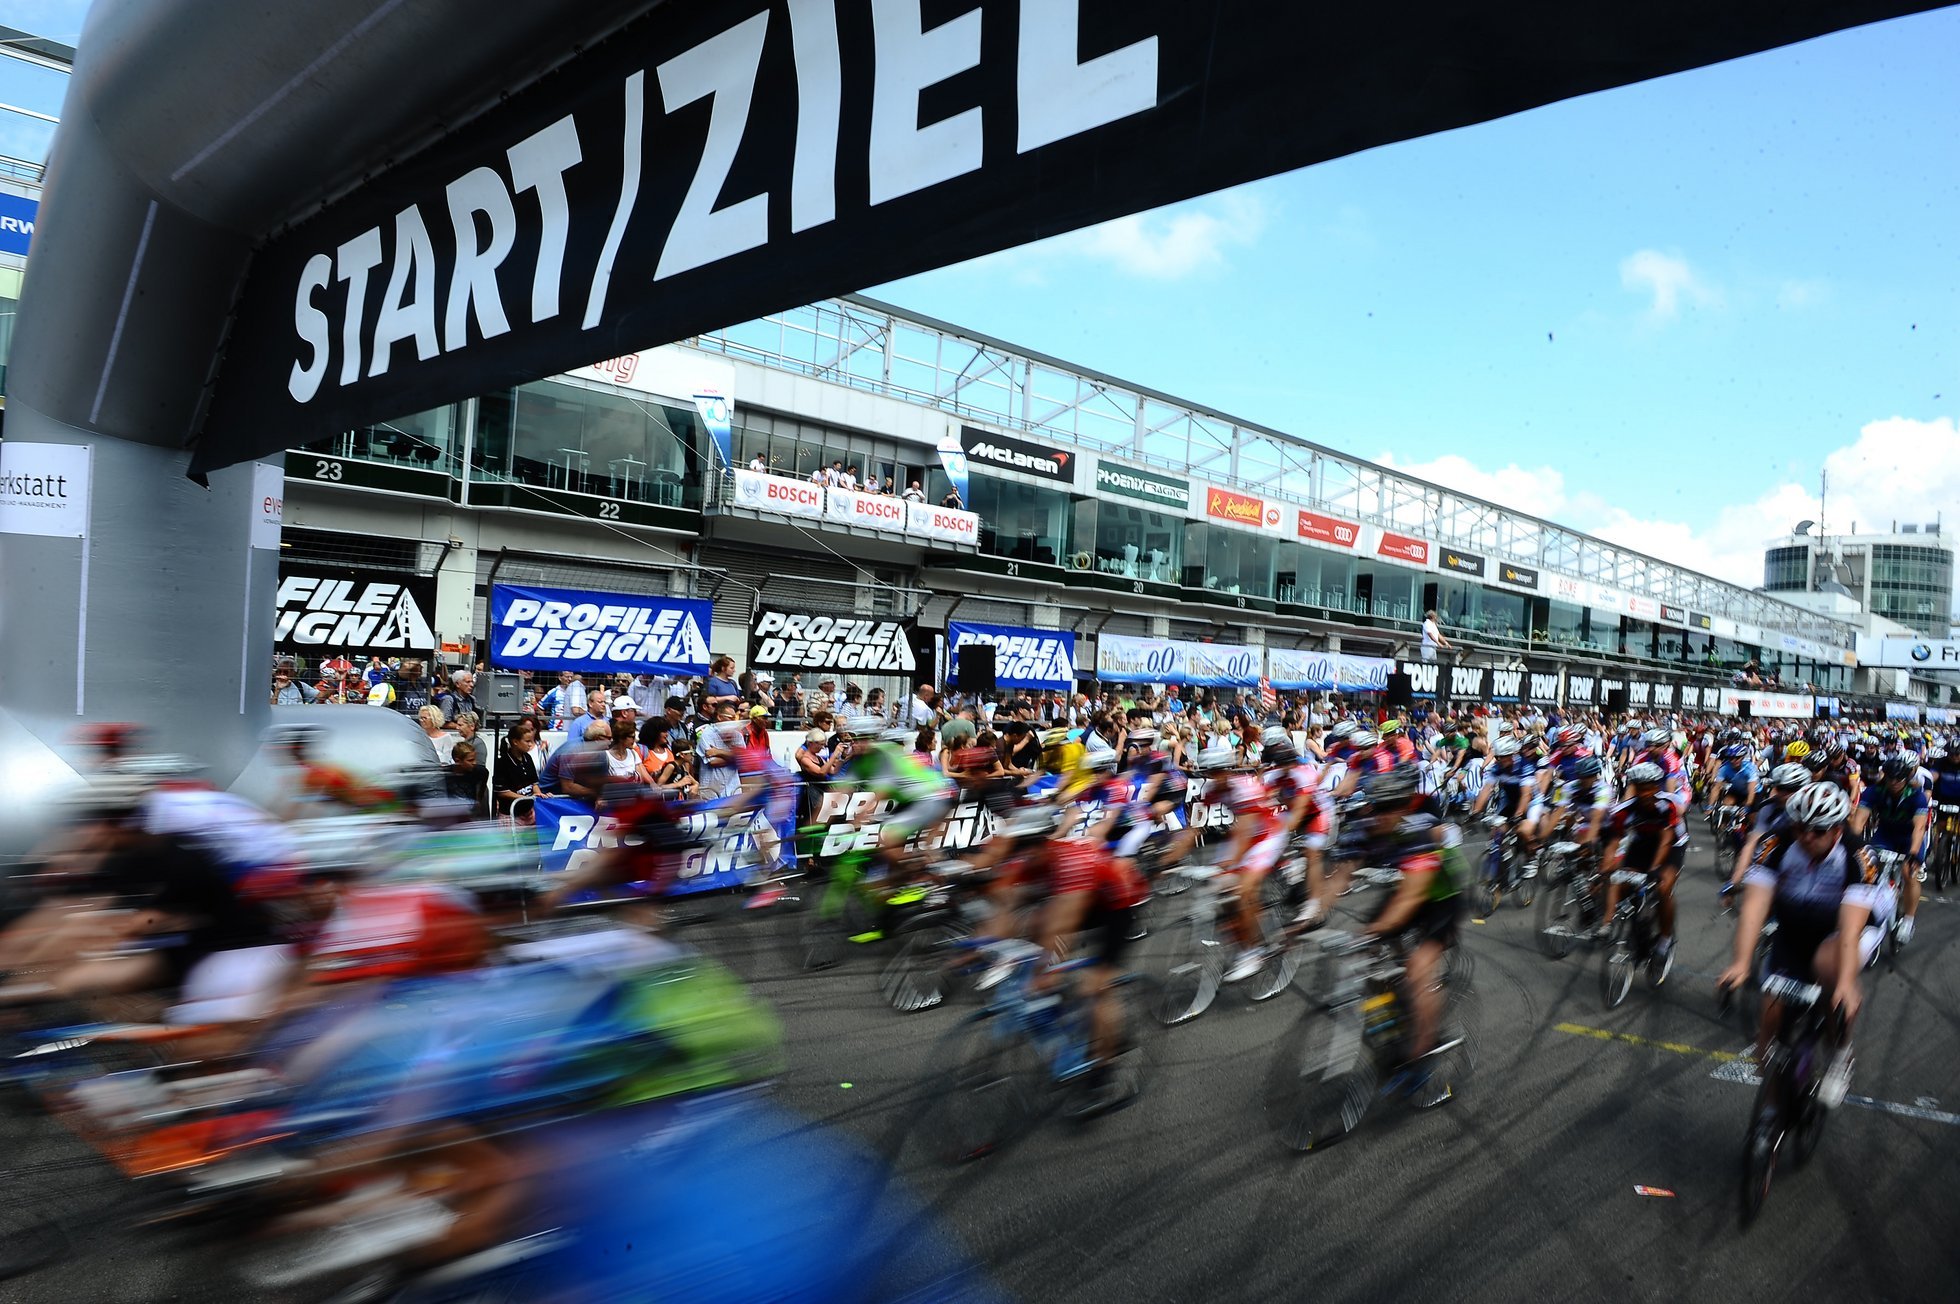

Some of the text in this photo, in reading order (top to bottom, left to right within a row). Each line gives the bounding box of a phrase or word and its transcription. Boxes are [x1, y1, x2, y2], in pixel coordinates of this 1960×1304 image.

[315, 460, 343, 481] 23
[968, 442, 1059, 475] McLaren
[767, 483, 818, 506] BOSCH
[599, 502, 620, 520] 22
[855, 499, 901, 521] BOSCH
[934, 513, 974, 533] BOSCH
[1007, 563, 1019, 576] 21
[276, 576, 401, 614] FILE
[1133, 582, 1144, 595] 20
[274, 610, 381, 647] IGN
[502, 598, 684, 636] PROFILE
[754, 611, 899, 646] PROFILE
[500, 627, 672, 663] DESIGN
[754, 637, 887, 670] DESIGN
